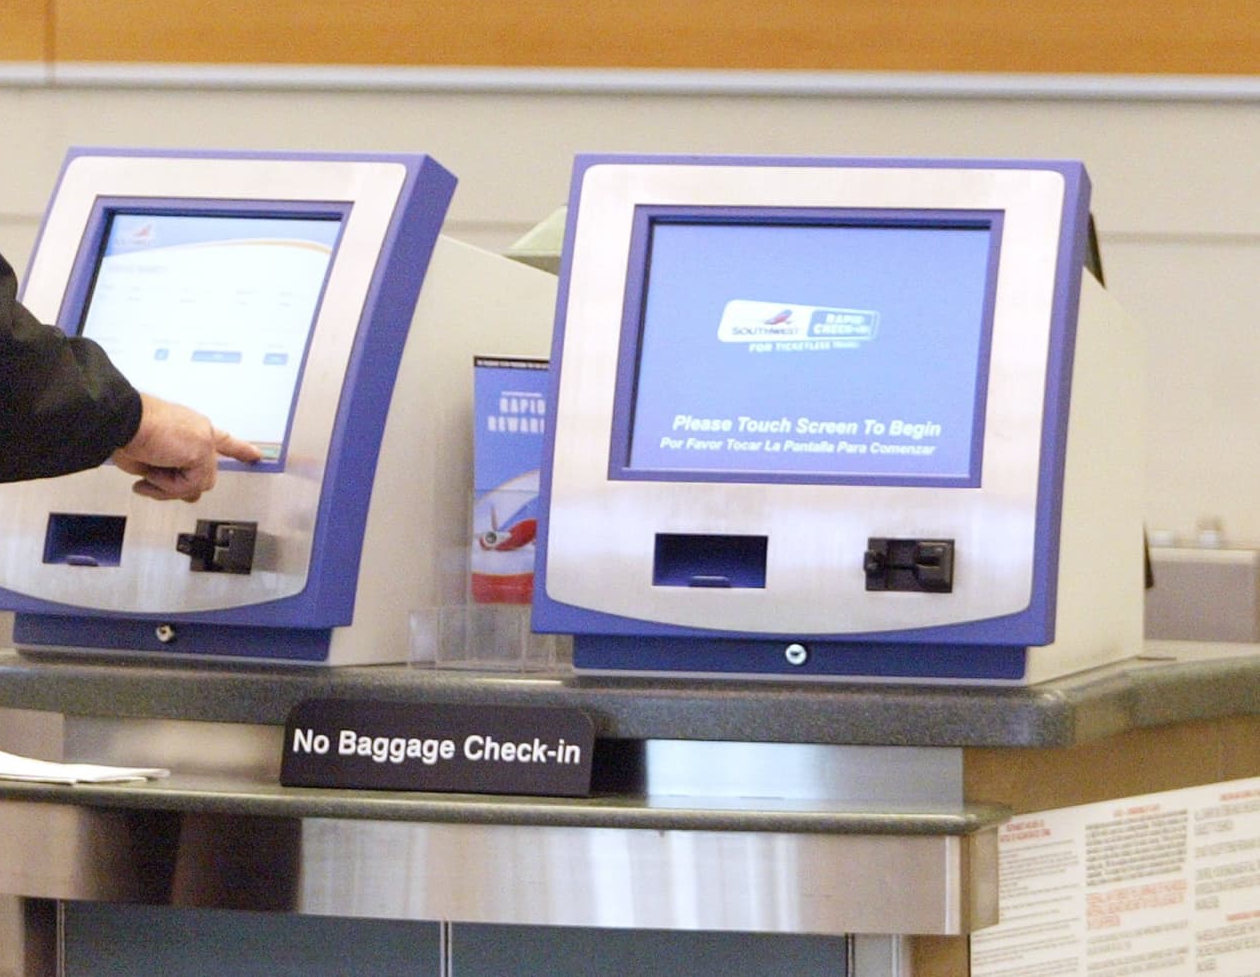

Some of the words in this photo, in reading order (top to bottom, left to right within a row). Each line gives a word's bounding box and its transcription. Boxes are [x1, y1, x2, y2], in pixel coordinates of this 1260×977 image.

[672, 414, 733, 432] Please
[737, 416, 792, 434] Touch
[795, 418, 858, 435] Screen
[863, 420, 885, 436] To
[889, 420, 942, 440] Begin
[660, 437, 682, 450] Por
[685, 438, 723, 451] Favor
[726, 439, 762, 452] Tocar
[764, 439, 781, 452] La
[837, 441, 867, 454] Para
[869, 442, 936, 456] Comenzar
[292, 727, 330, 755] No
[338, 729, 456, 765] Baggage
[463, 733, 581, 766] Check-in
